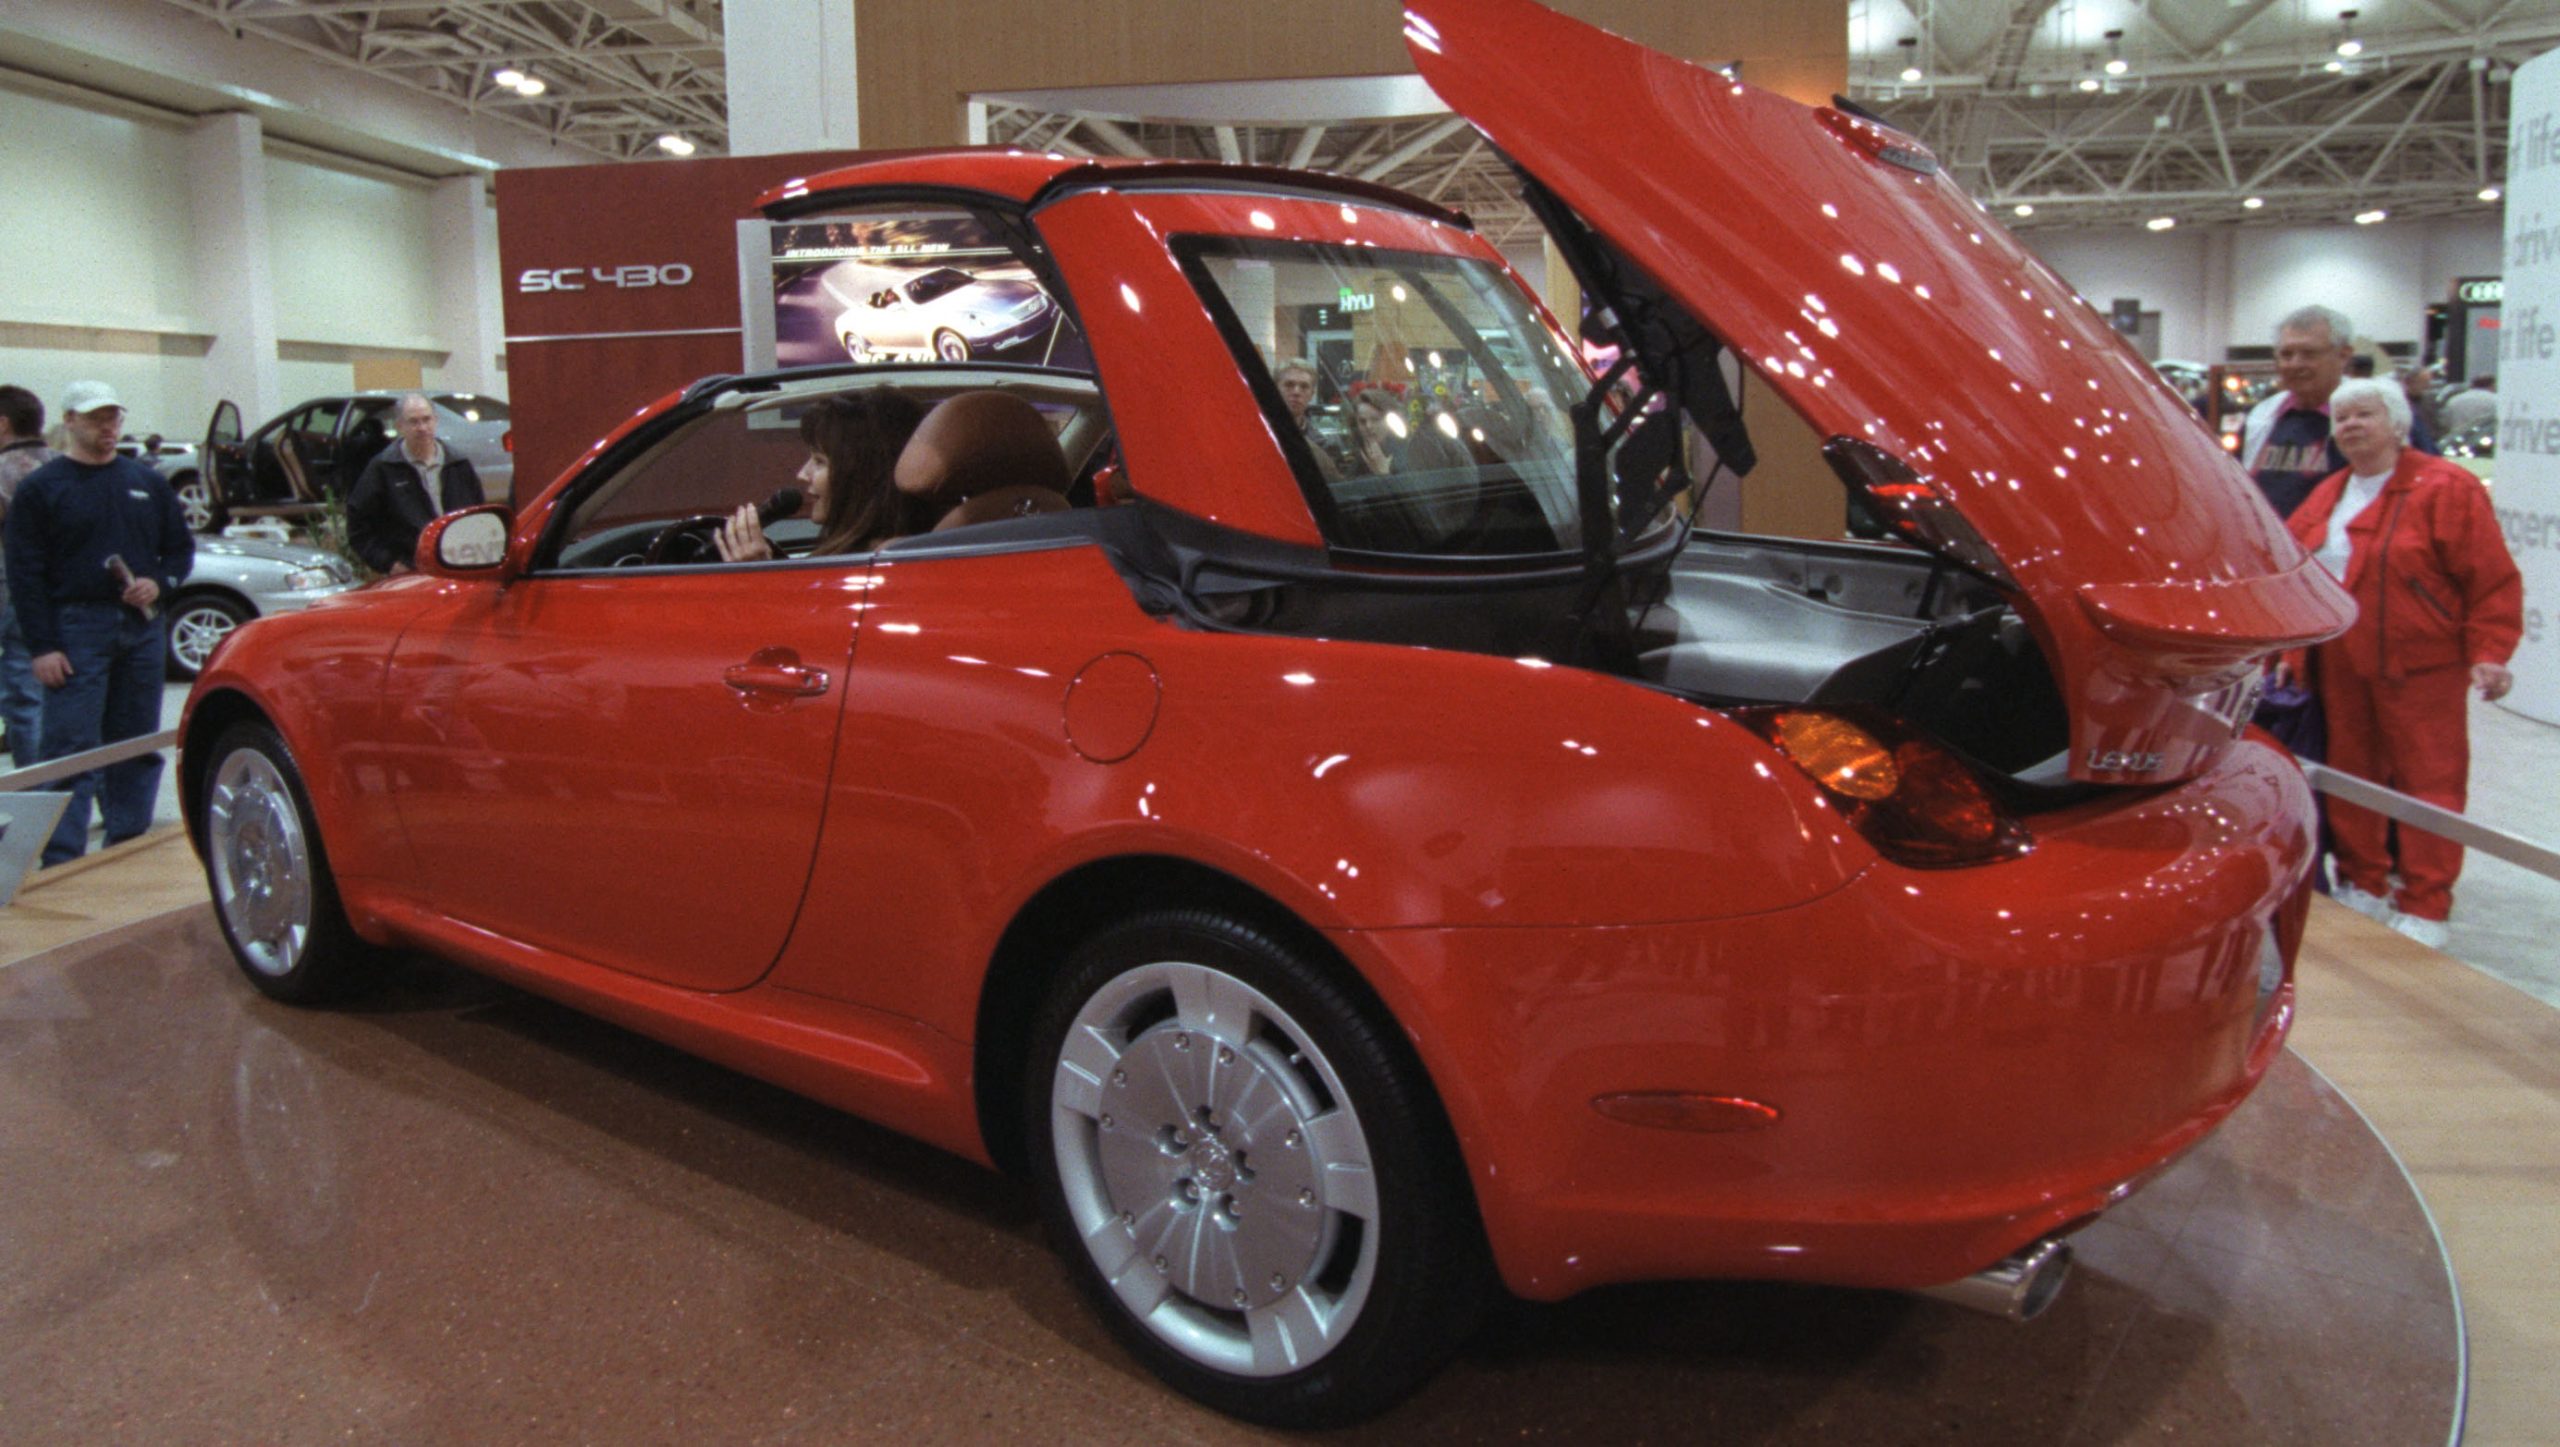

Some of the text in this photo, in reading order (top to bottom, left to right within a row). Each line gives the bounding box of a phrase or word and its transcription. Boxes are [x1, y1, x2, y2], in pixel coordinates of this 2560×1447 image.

[785, 243, 951, 258] INTRODUCING THE ALL NEW
[520, 263, 693, 292] SC 430
